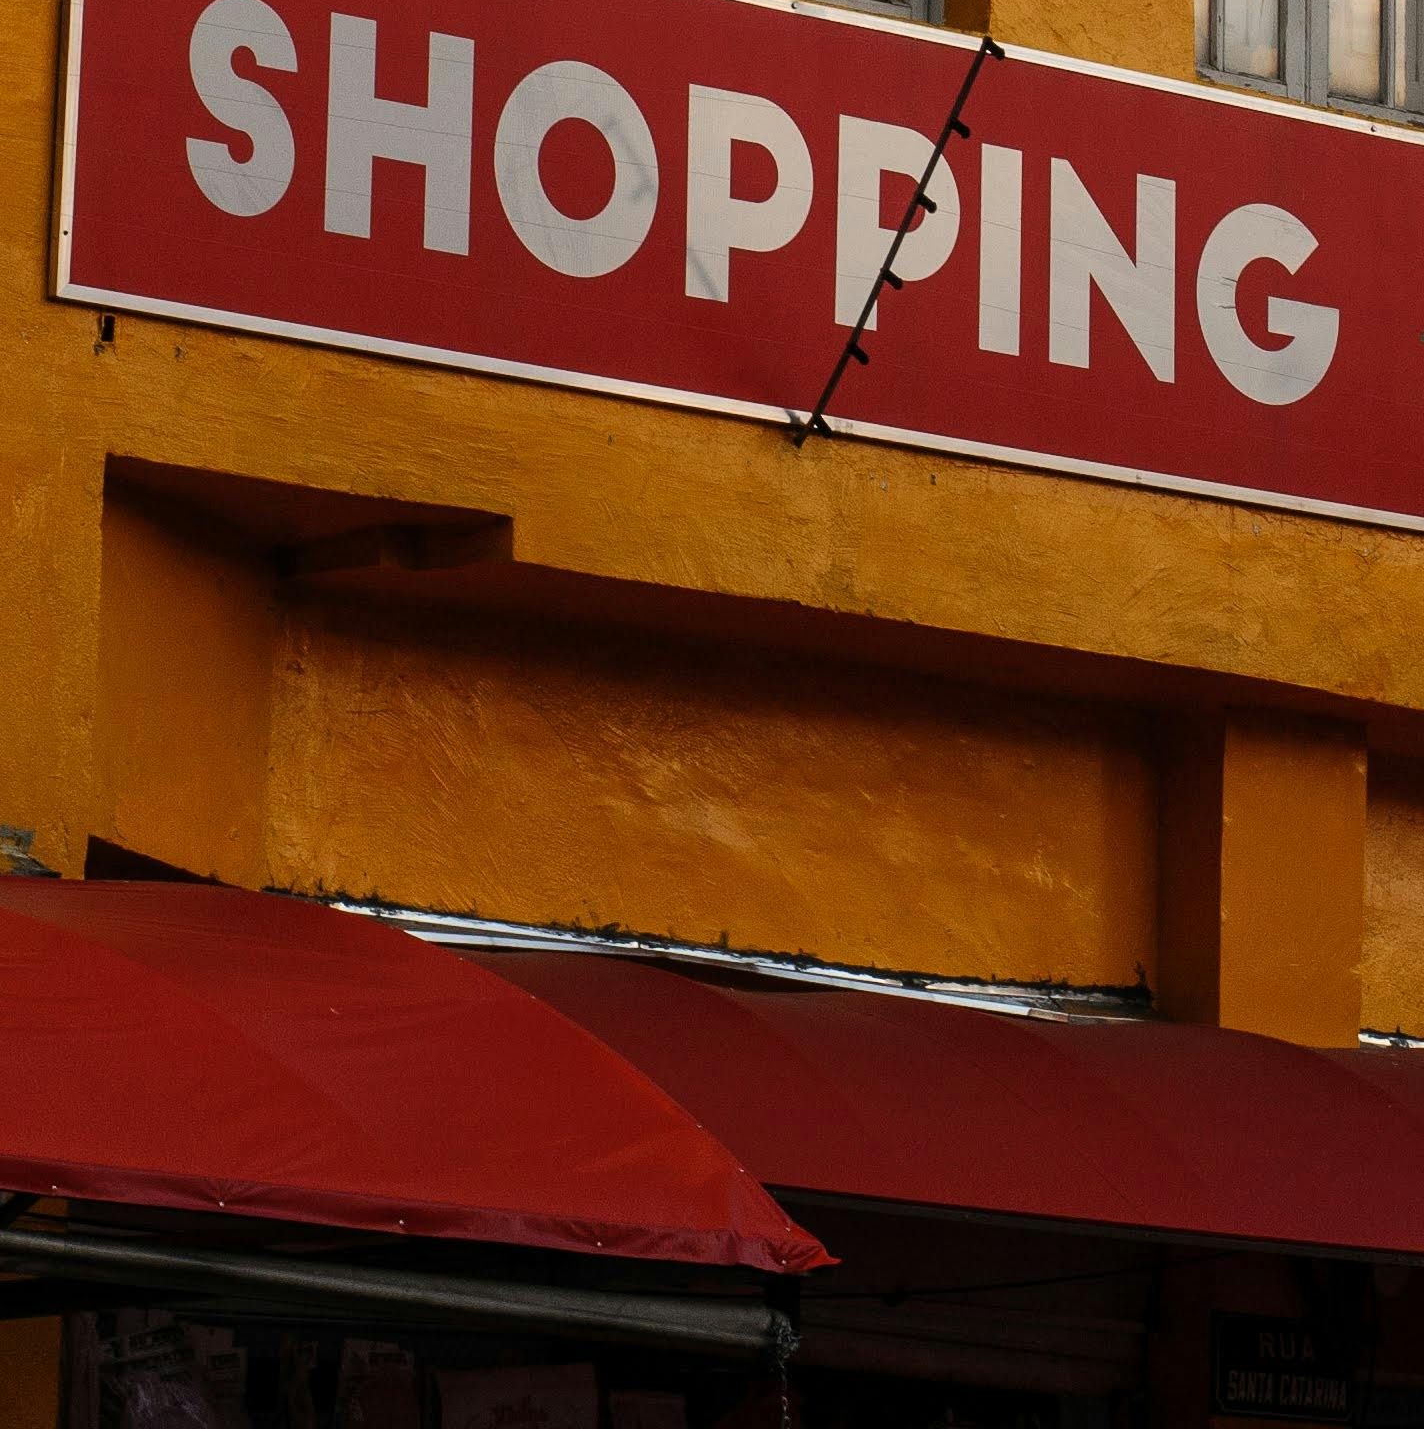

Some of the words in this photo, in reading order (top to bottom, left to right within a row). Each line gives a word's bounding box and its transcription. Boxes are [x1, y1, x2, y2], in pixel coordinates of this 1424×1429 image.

[1258, 1331, 1318, 1364] RUA
[1226, 1368, 1274, 1405] SANTA
[1278, 1372, 1347, 1412] CATARINA
